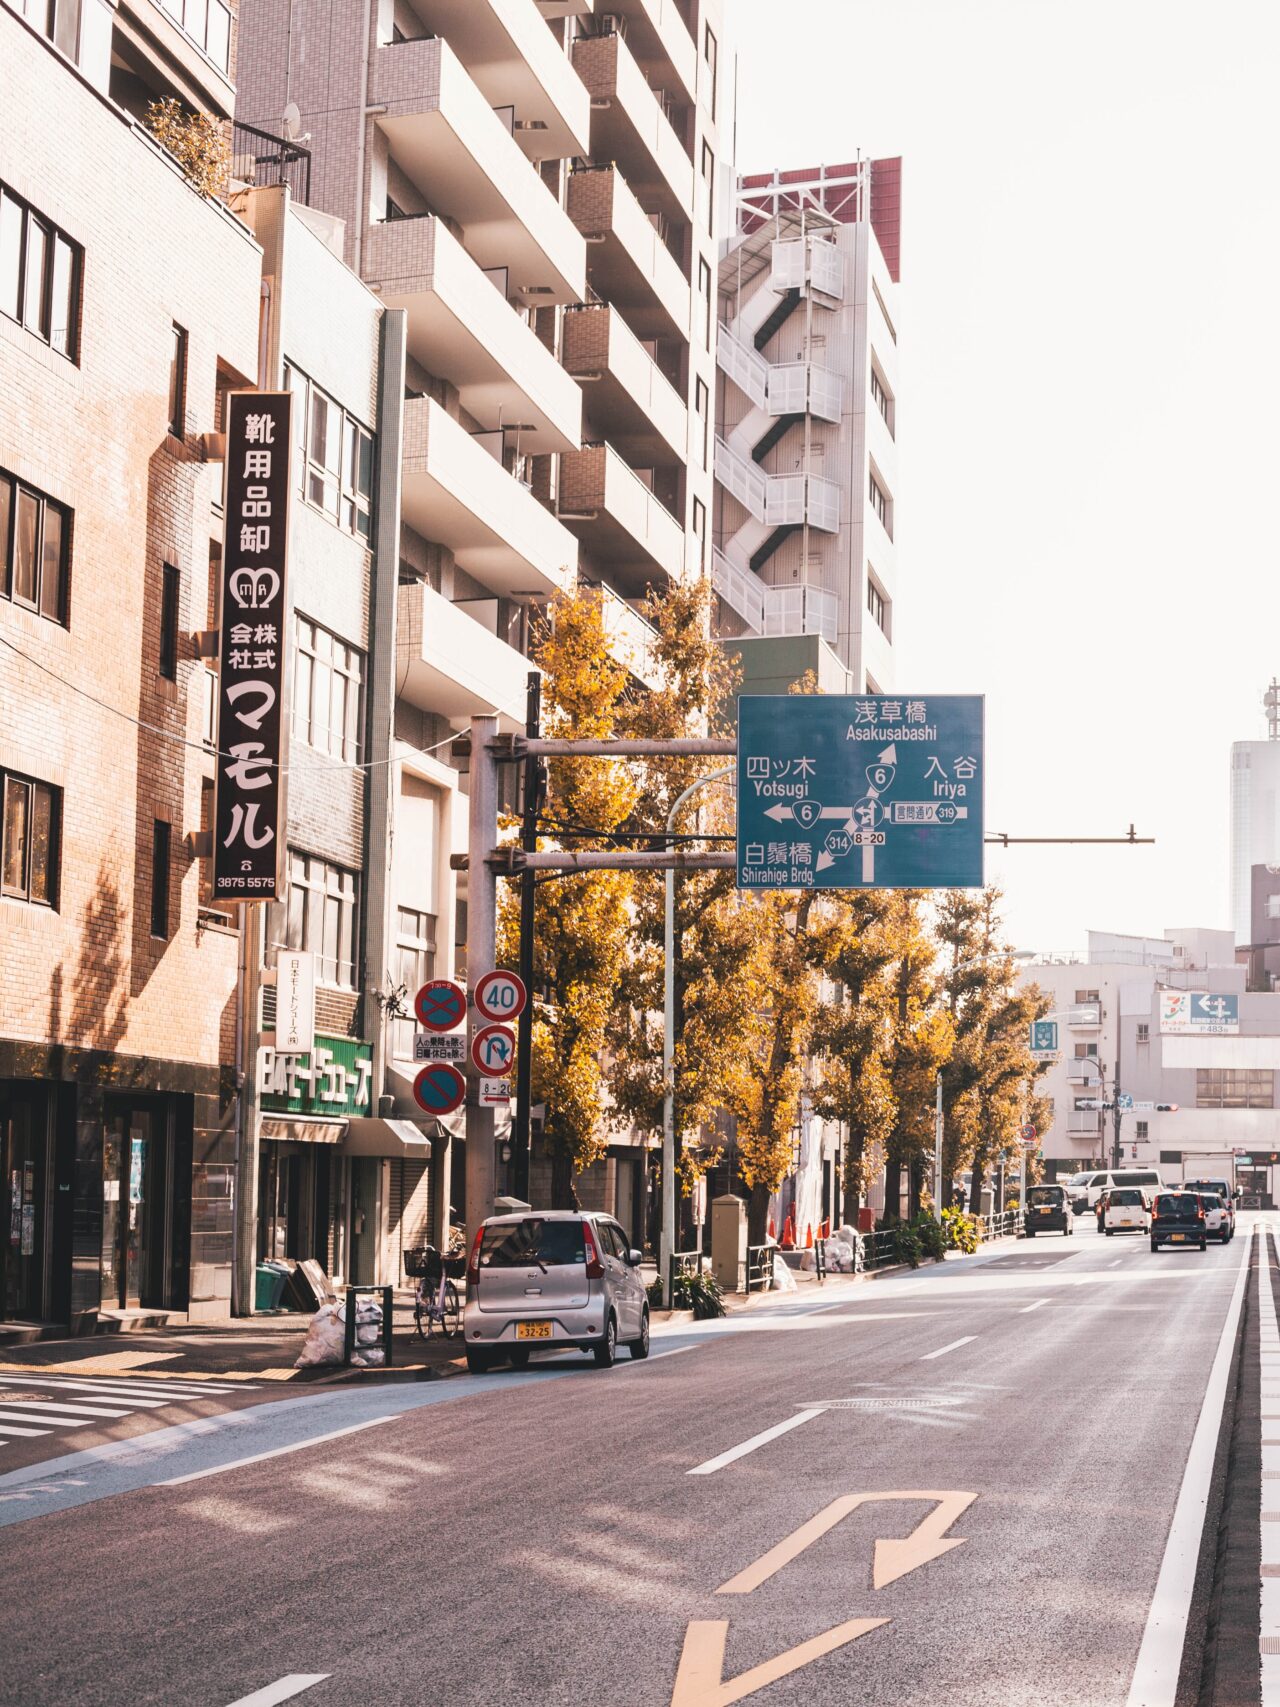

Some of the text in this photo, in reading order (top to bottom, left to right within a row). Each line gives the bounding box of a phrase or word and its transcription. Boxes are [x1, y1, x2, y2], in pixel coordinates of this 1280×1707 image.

[240, 413, 275, 555] 靴用品卸
[854, 701, 927, 724] 浅草橋
[846, 725, 937, 741] Asakusabashi
[224, 680, 276, 849] マモル
[747, 756, 817, 780] 四ツ木
[923, 756, 977, 779] 入谷
[874, 770, 886, 784] 6
[753, 780, 809, 799] Yotsugi
[933, 780, 967, 799] Iriya
[801, 806, 812, 821] 6
[897, 806, 955, 820] 言問通り 319
[828, 836, 848, 850] 314
[855, 833, 884, 843] 8-20
[217, 877, 275, 888] 3875 5575
[742, 868, 815, 885] Shirahige Brdg.
[487, 985, 514, 1008] 40
